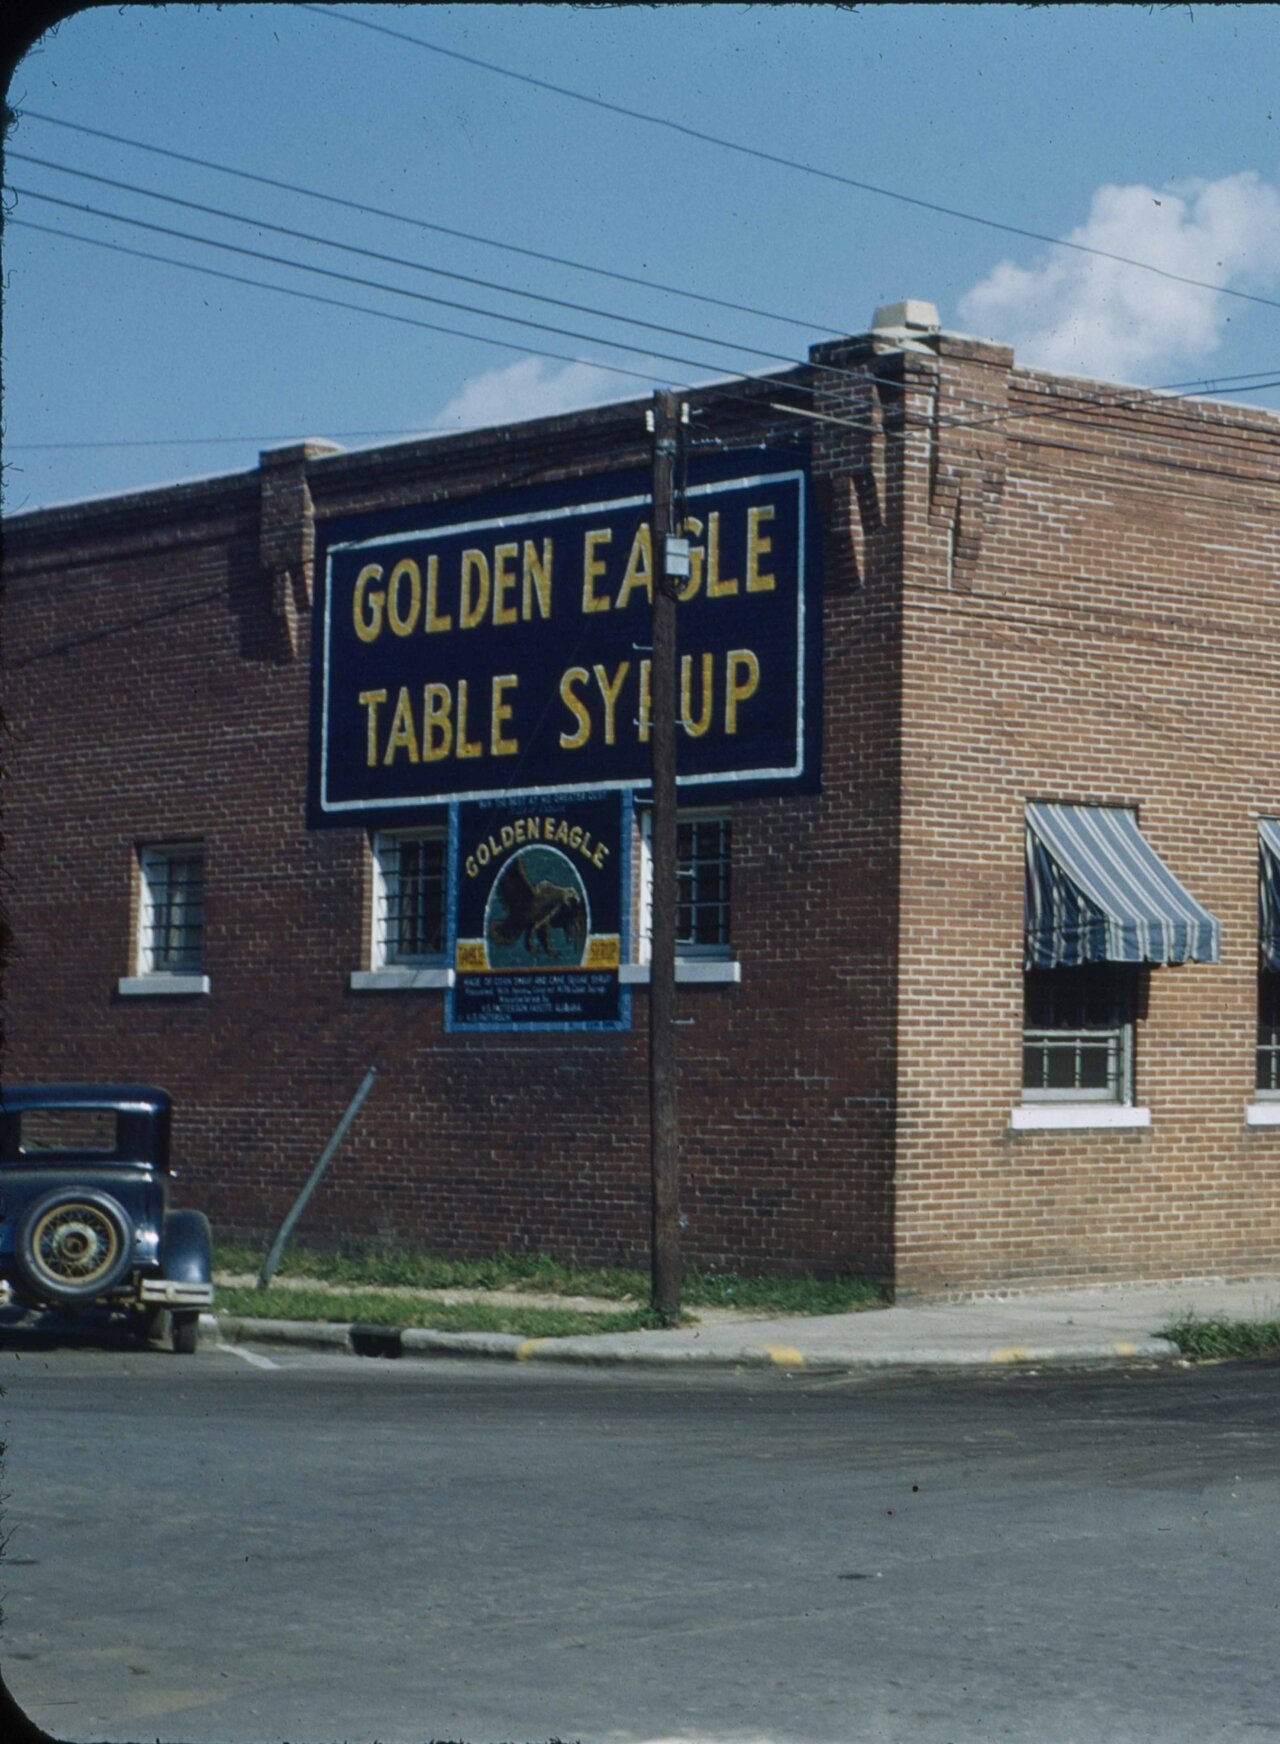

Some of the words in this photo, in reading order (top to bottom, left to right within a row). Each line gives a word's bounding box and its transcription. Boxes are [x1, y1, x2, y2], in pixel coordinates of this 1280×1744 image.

[352, 537, 553, 643] GOLDEN
[582, 505, 776, 614] EAGLE
[358, 674, 519, 768] TABLE
[465, 816, 540, 878] GOLDEN
[543, 817, 611, 870] EAGLE
[590, 942, 617, 961] SYRUP
